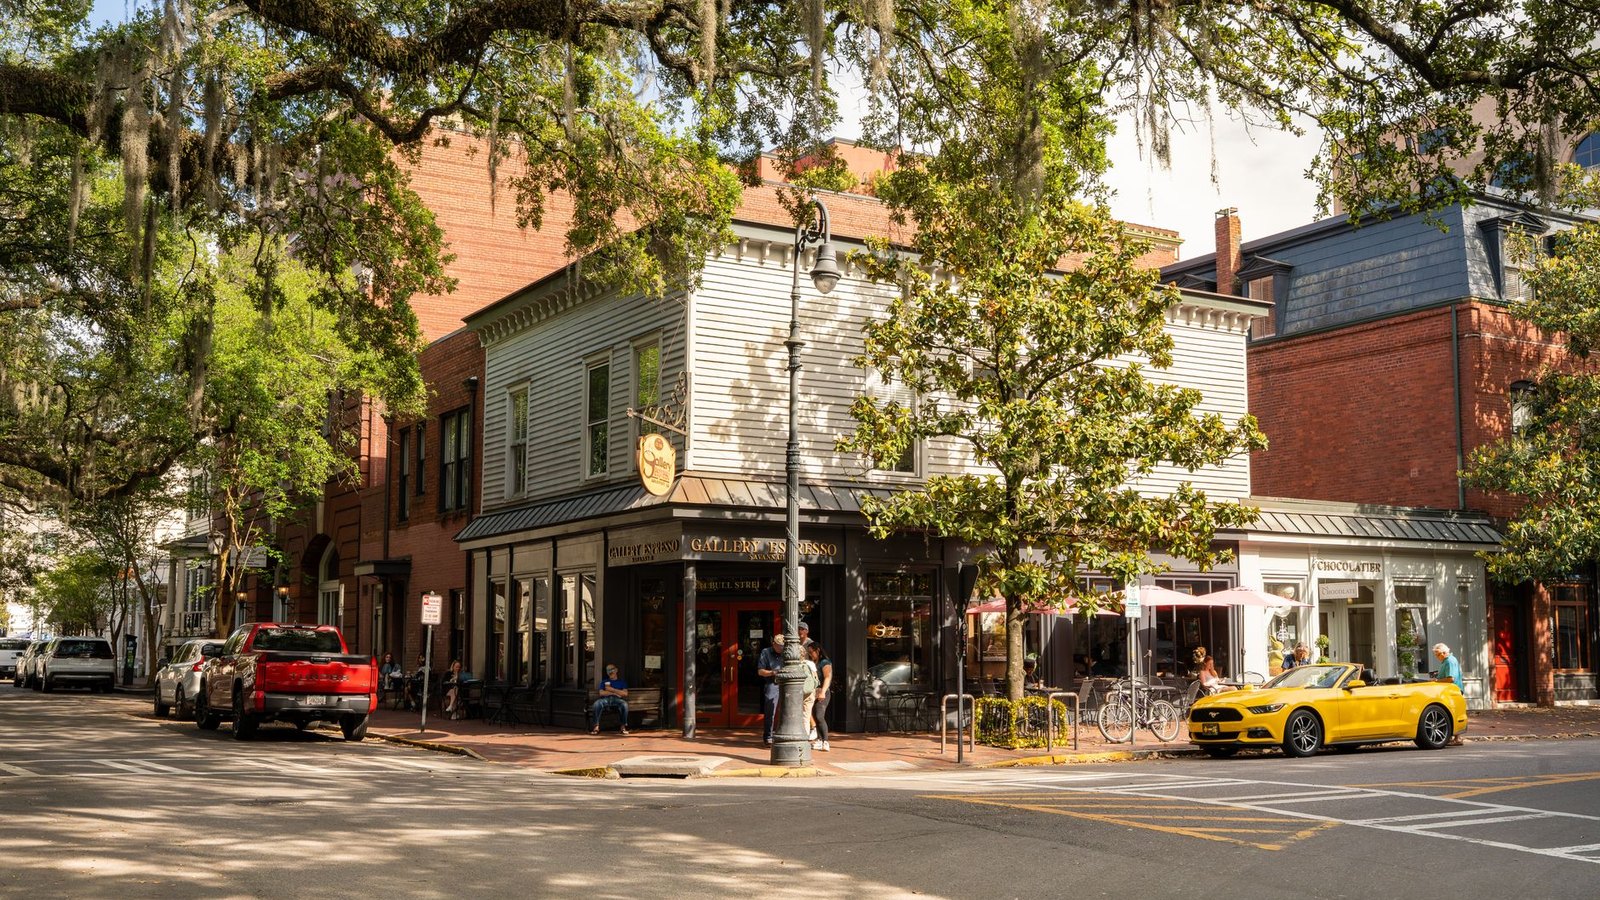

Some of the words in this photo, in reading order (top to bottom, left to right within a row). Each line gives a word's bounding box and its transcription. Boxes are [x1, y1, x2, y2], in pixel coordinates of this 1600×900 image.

[608, 544, 641, 558] GALLERY
[691, 538, 760, 553] GALLERY
[770, 541, 837, 556] ESRESSO
[1317, 561, 1381, 573] CHOCOLATIER
[709, 580, 733, 589] BULL
